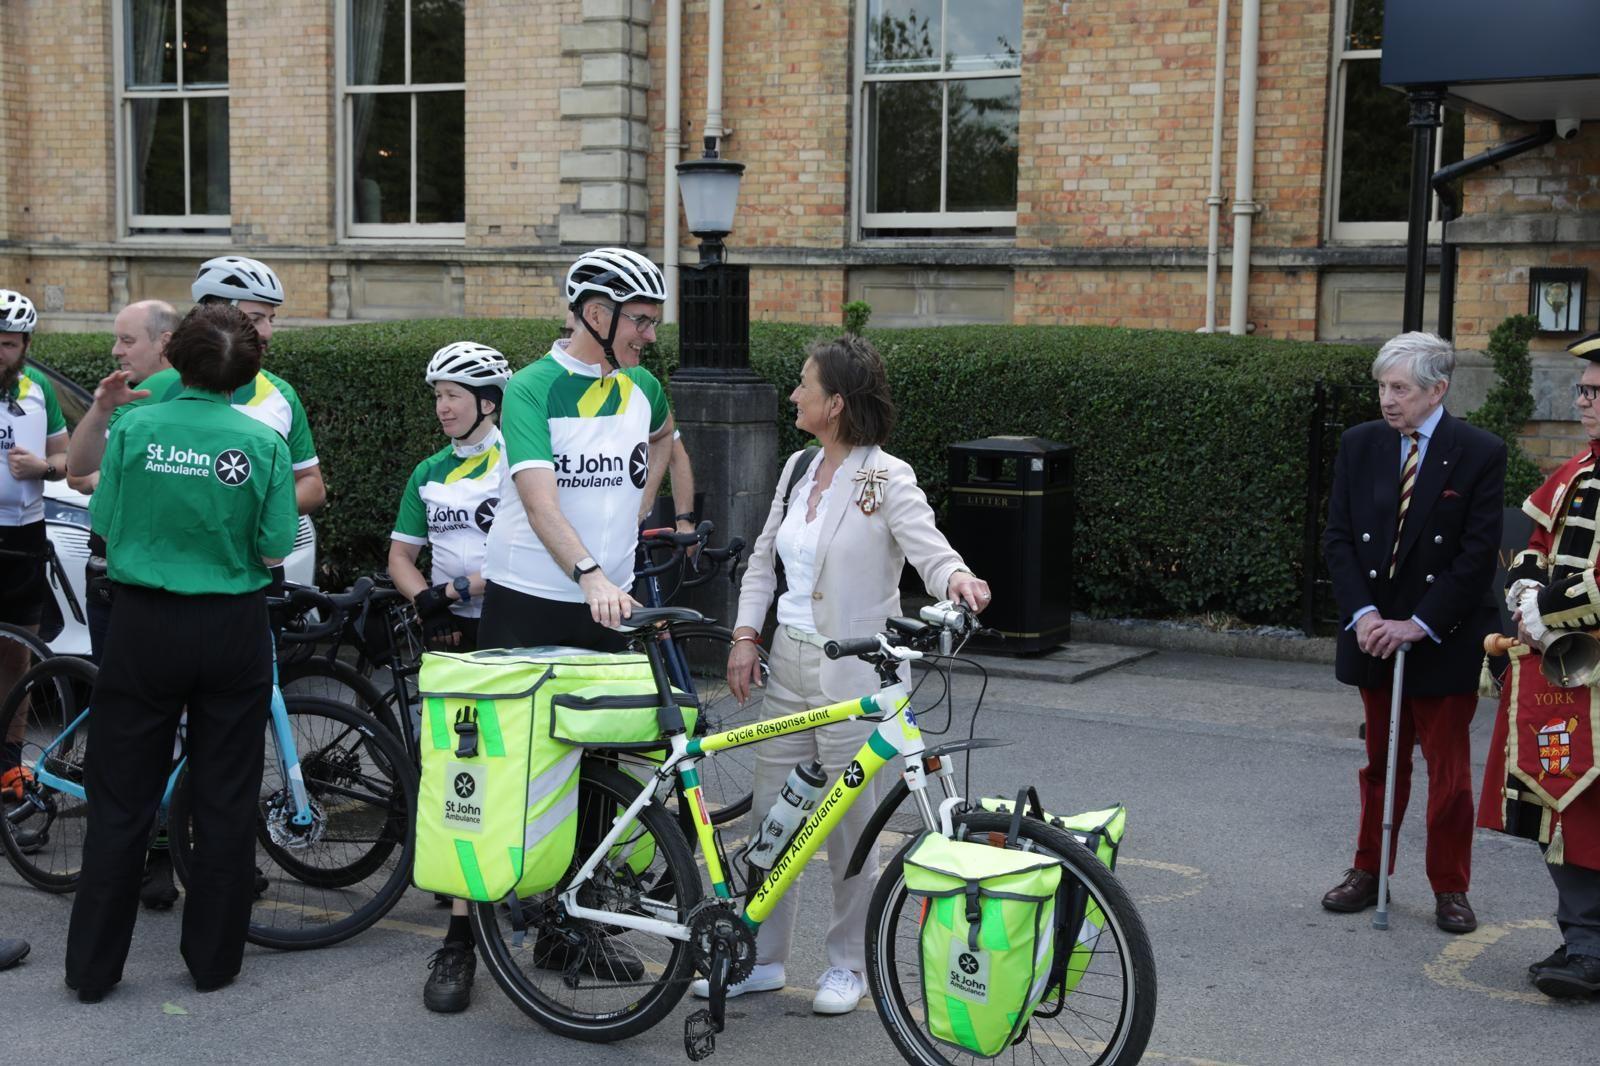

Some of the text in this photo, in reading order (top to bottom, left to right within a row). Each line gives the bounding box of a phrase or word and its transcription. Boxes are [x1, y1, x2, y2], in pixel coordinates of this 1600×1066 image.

[147, 443, 210, 466] St John
[145, 463, 209, 477] Ambulance
[575, 453, 623, 474] John
[557, 475, 623, 488] mbulance
[968, 496, 1008, 508] LITTER
[433, 506, 469, 522] John
[1534, 692, 1575, 706] YORK
[726, 709, 830, 742] Cycle Response Unit
[446, 801, 481, 815] St John
[445, 812, 481, 824] Ambulance
[757, 883, 770, 902] St
[768, 855, 791, 890] John
[791, 788, 843, 859] Ambulance
[951, 971, 986, 990] St John
[950, 981, 986, 997] Ambulance
